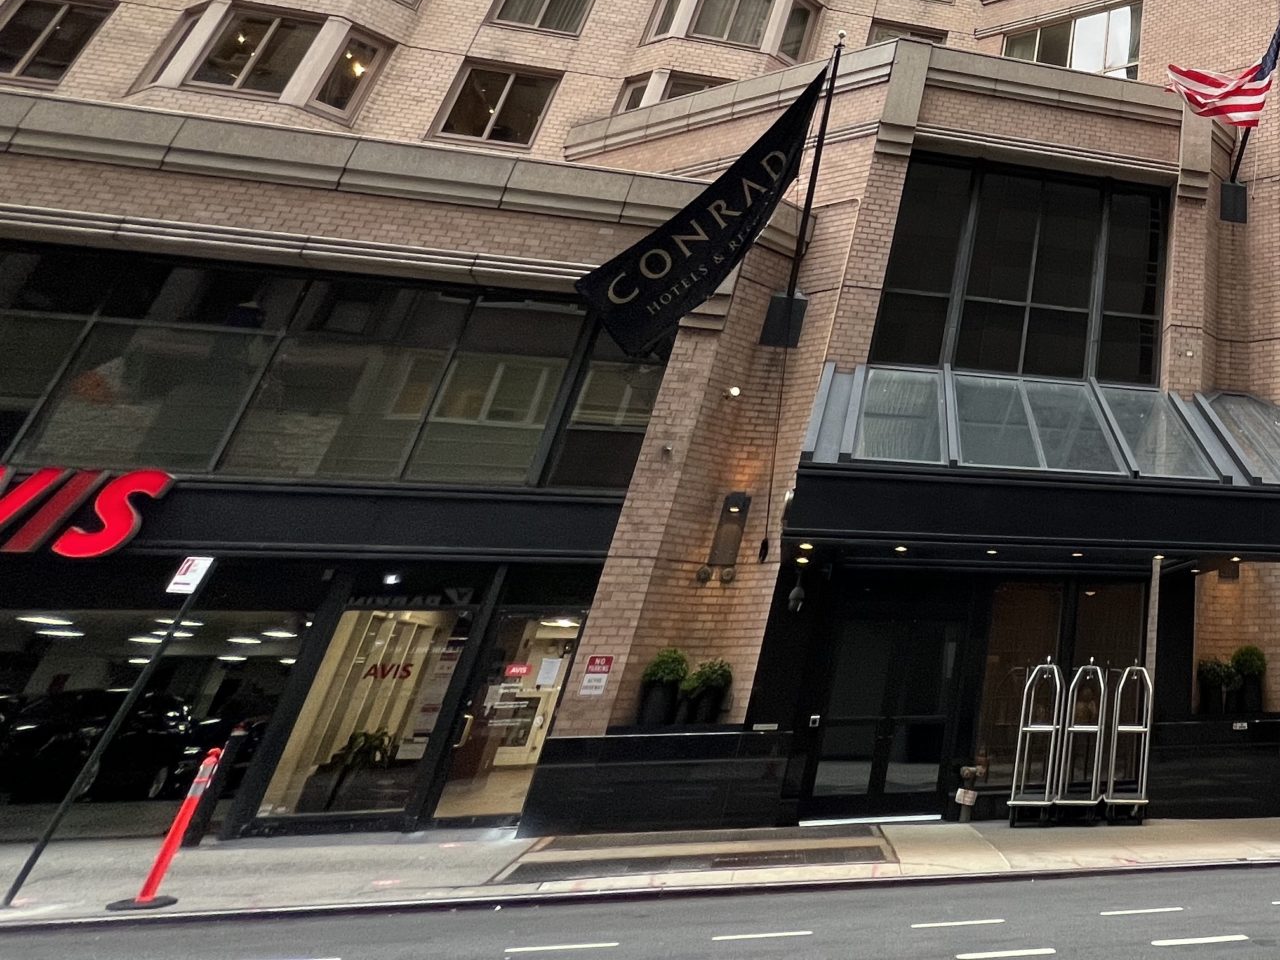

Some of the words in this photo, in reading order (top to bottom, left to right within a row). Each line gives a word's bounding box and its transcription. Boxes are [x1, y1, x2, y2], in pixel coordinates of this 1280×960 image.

[607, 150, 790, 304] CONRAD
[646, 263, 709, 316] HOTELS
[363, 663, 414, 680] AVIS
[509, 666, 528, 674] AVIS
